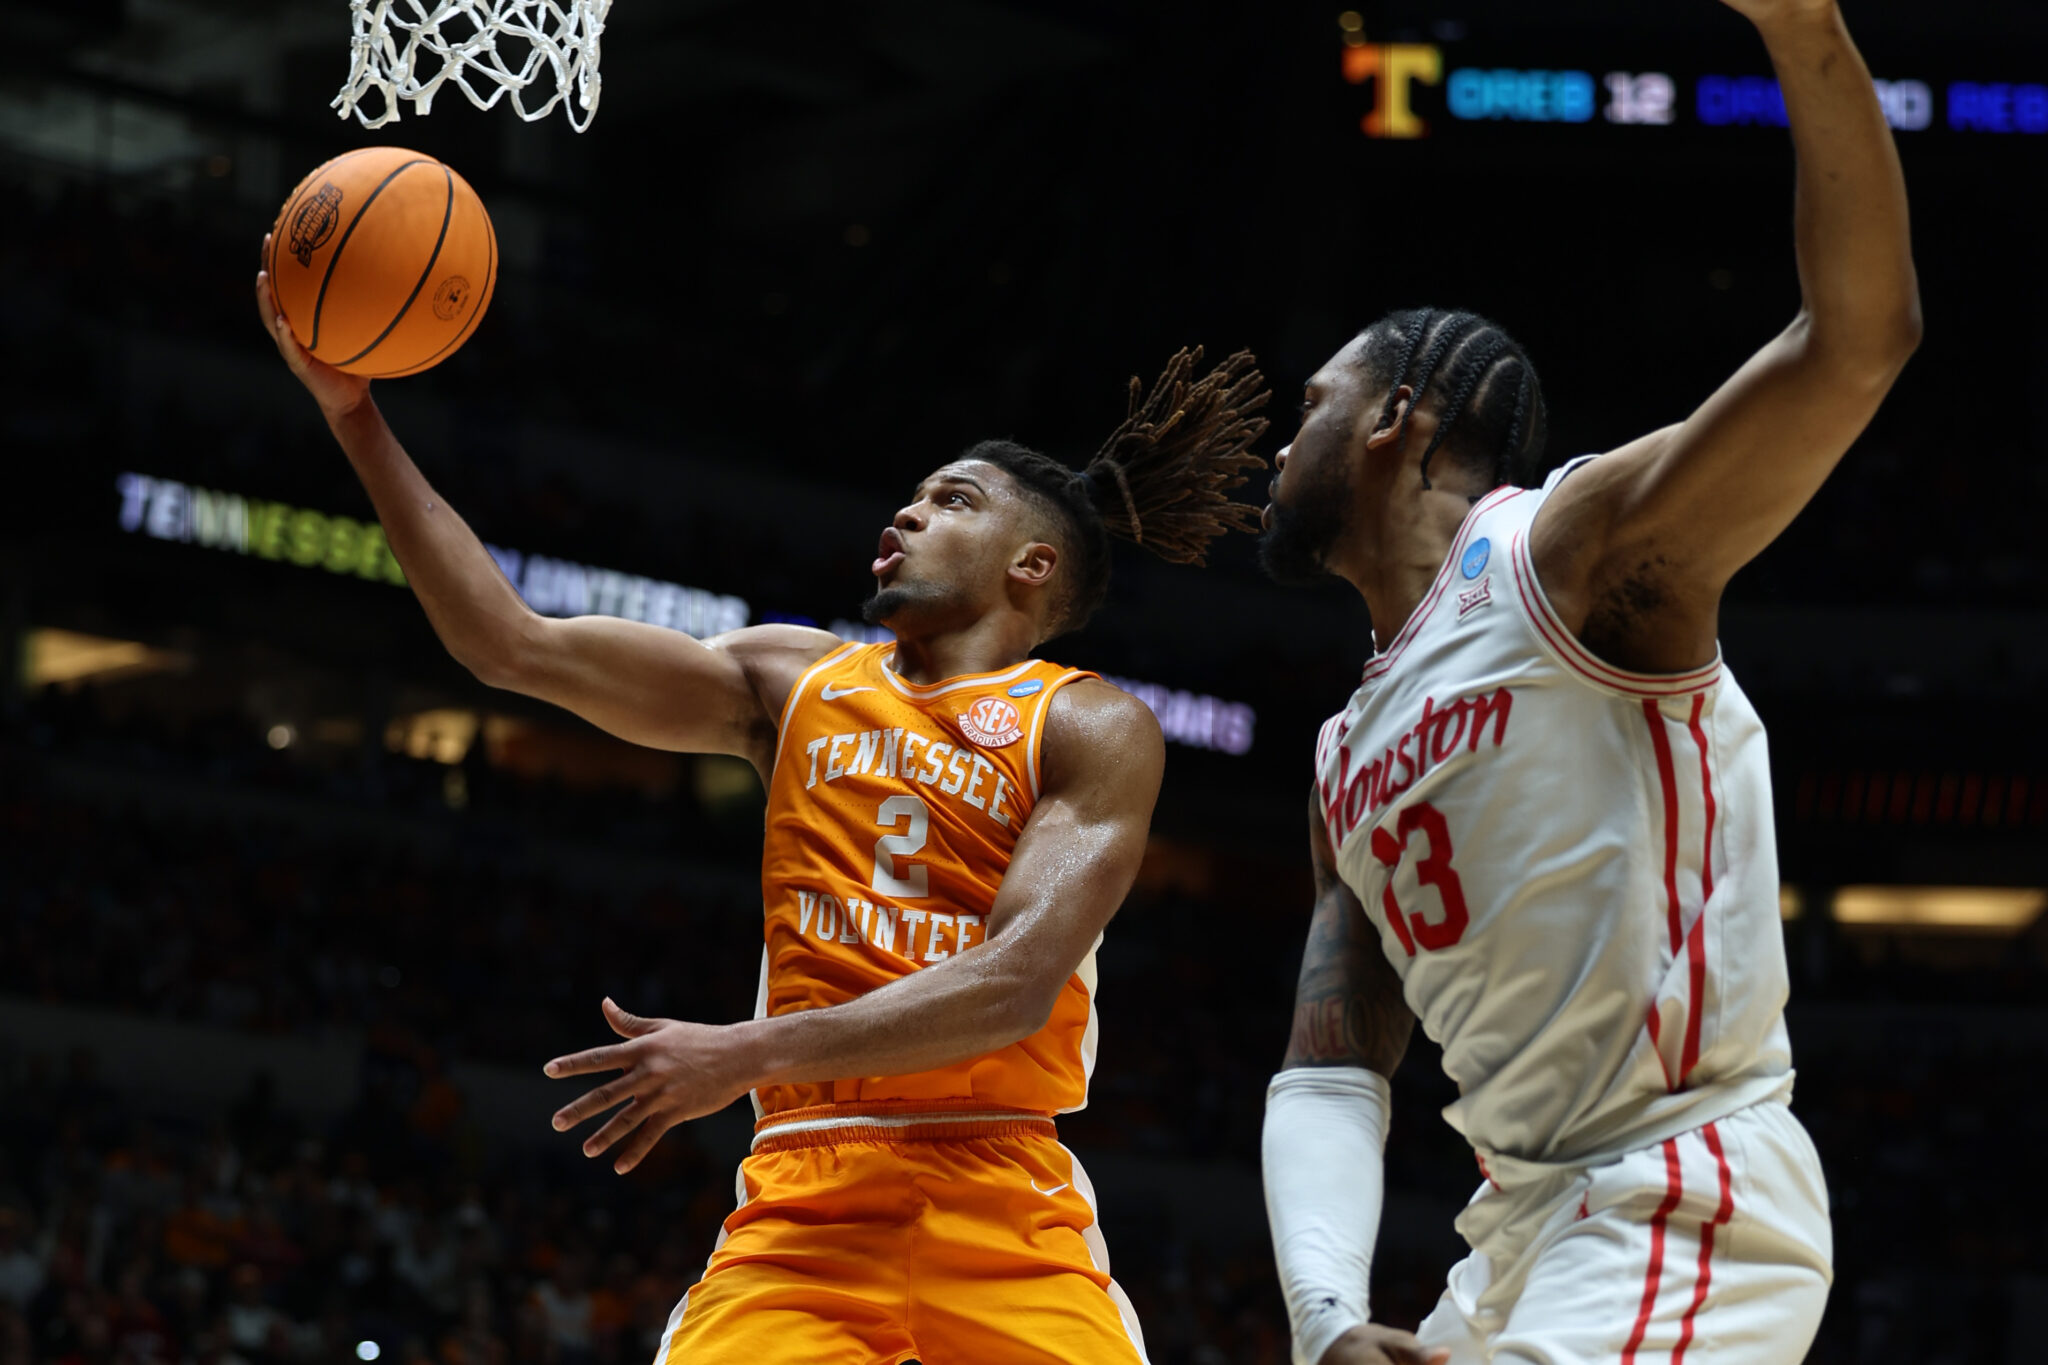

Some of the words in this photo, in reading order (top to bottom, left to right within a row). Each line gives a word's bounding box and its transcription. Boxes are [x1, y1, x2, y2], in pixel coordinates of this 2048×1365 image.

[1341, 42, 1444, 140] T
[1446, 66, 1597, 123] OREB
[1602, 70, 1676, 125] 12
[961, 722, 1011, 746] GRADUATE
[973, 700, 1016, 733] SEC
[806, 727, 1015, 827] TENNESSEE
[1322, 686, 1513, 851] Houston
[871, 795, 929, 898] 2
[1371, 801, 1470, 957] 13
[797, 890, 991, 962] VOLUNTEE
